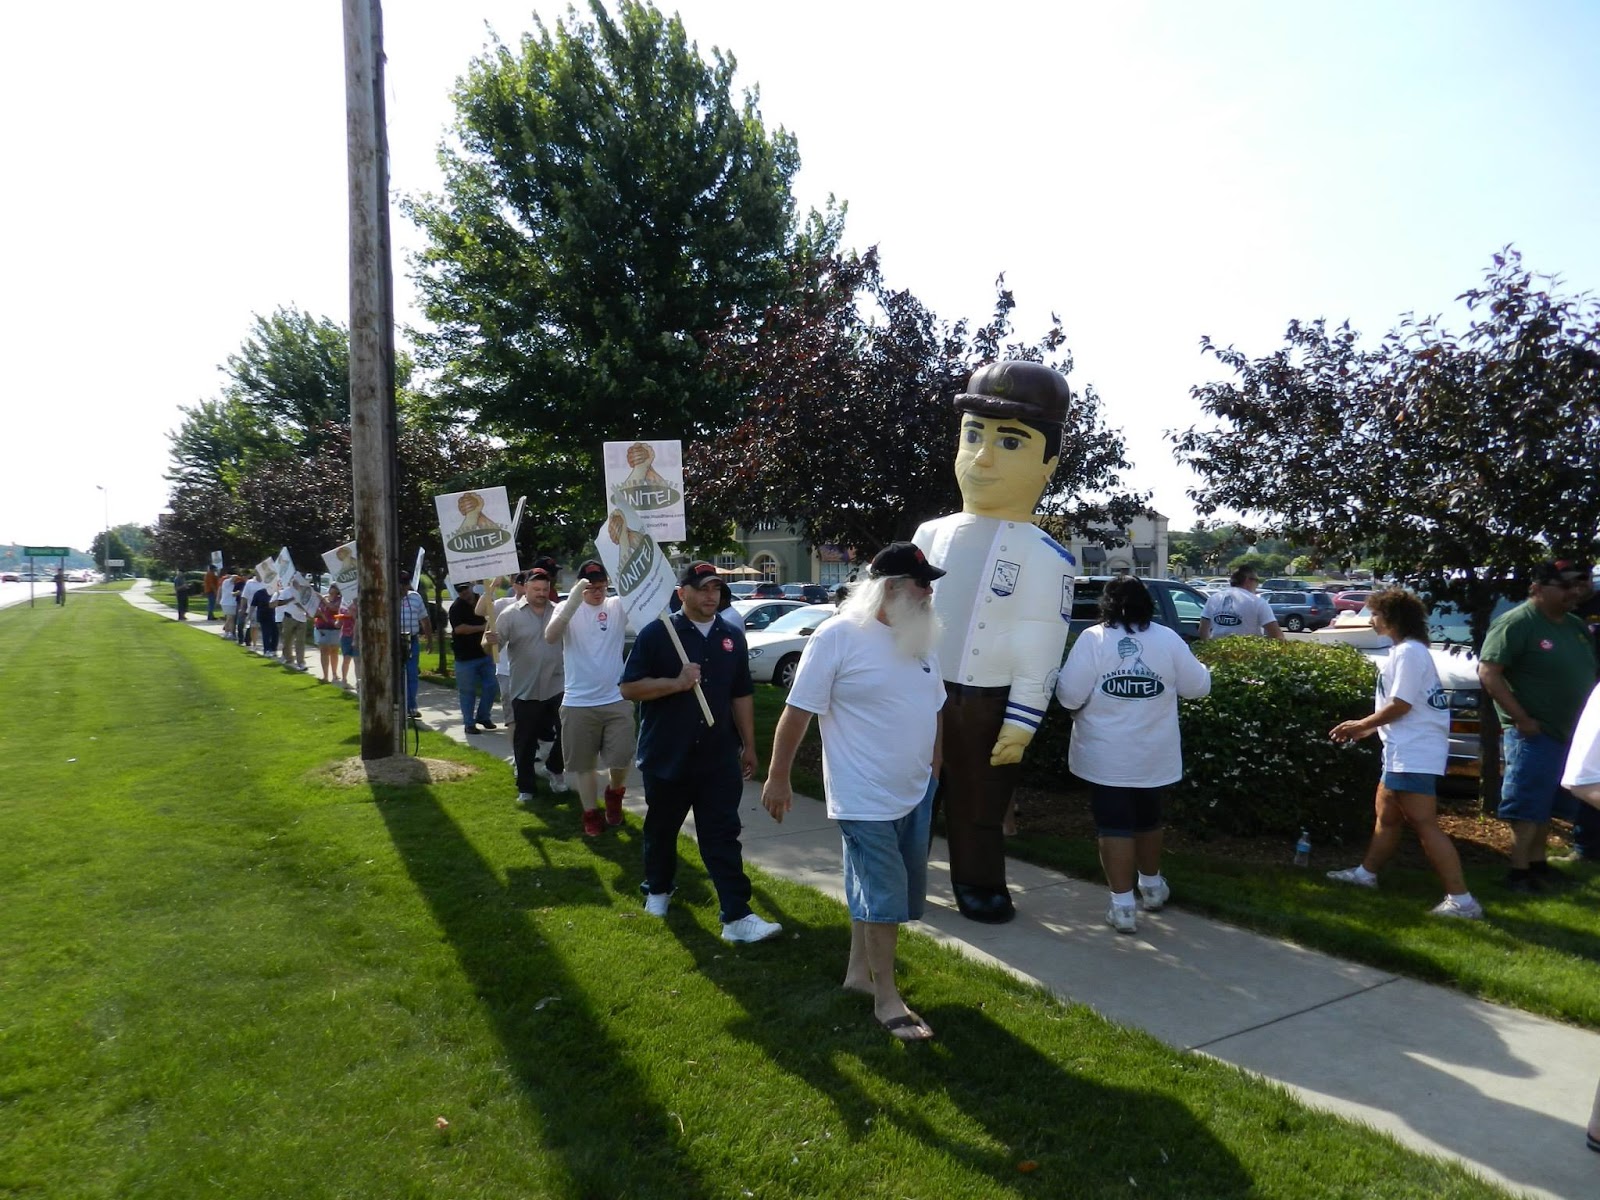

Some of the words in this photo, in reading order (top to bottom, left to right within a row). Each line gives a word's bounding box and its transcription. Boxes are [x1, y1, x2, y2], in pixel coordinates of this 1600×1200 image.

[453, 530, 503, 551] UNITE!
[620, 538, 652, 592] UNITE!
[1107, 679, 1158, 695] UNITE!
